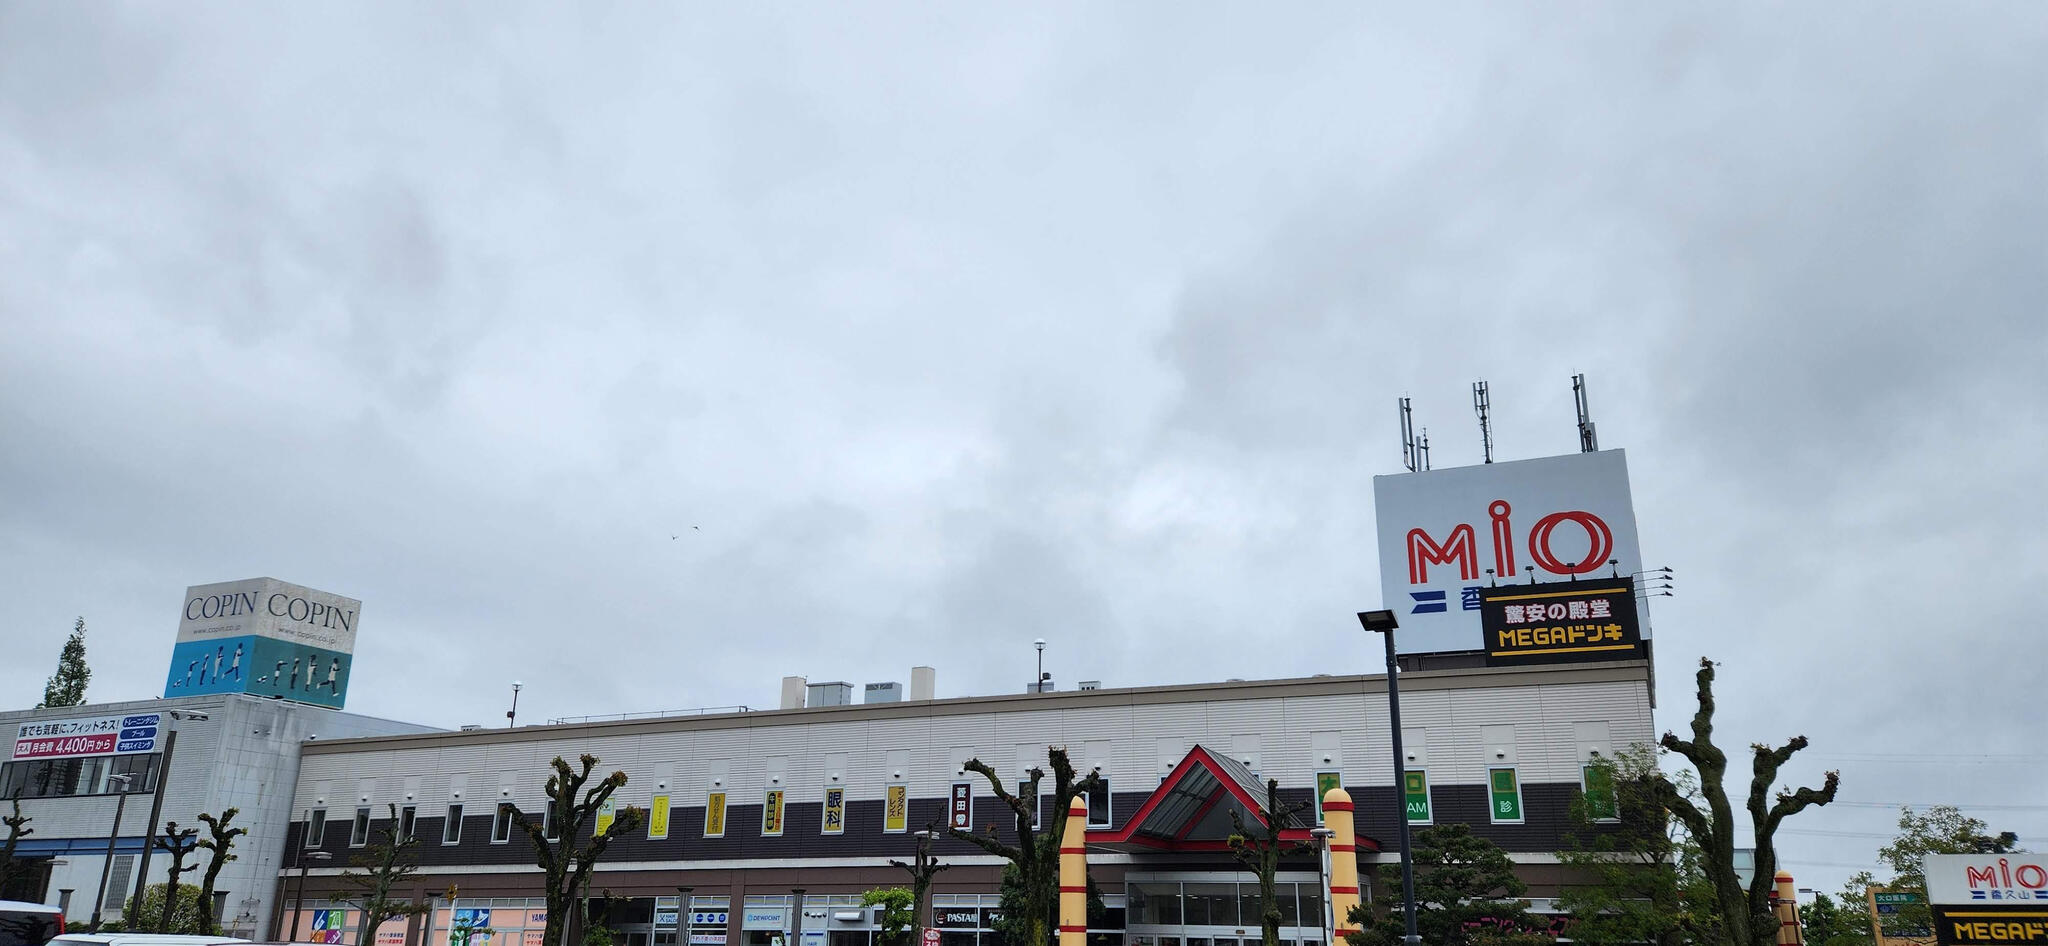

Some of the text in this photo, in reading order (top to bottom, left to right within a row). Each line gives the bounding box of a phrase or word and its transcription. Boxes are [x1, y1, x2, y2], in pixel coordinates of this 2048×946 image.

[185, 591, 260, 621] COPIN
[267, 593, 354, 632] COPIN
[1504, 599, 1612, 624] 驚安の殿堂
[193, 625, 241, 635] www.copin.co.jp
[278, 627, 336, 645] www.copin.co.jp
[1498, 622, 1624, 648] MEGAドンキ
[826, 791, 842, 828] 眼科
[897, 787, 905, 817] コンタクト
[1954, 922, 2048, 941] MEGAド
